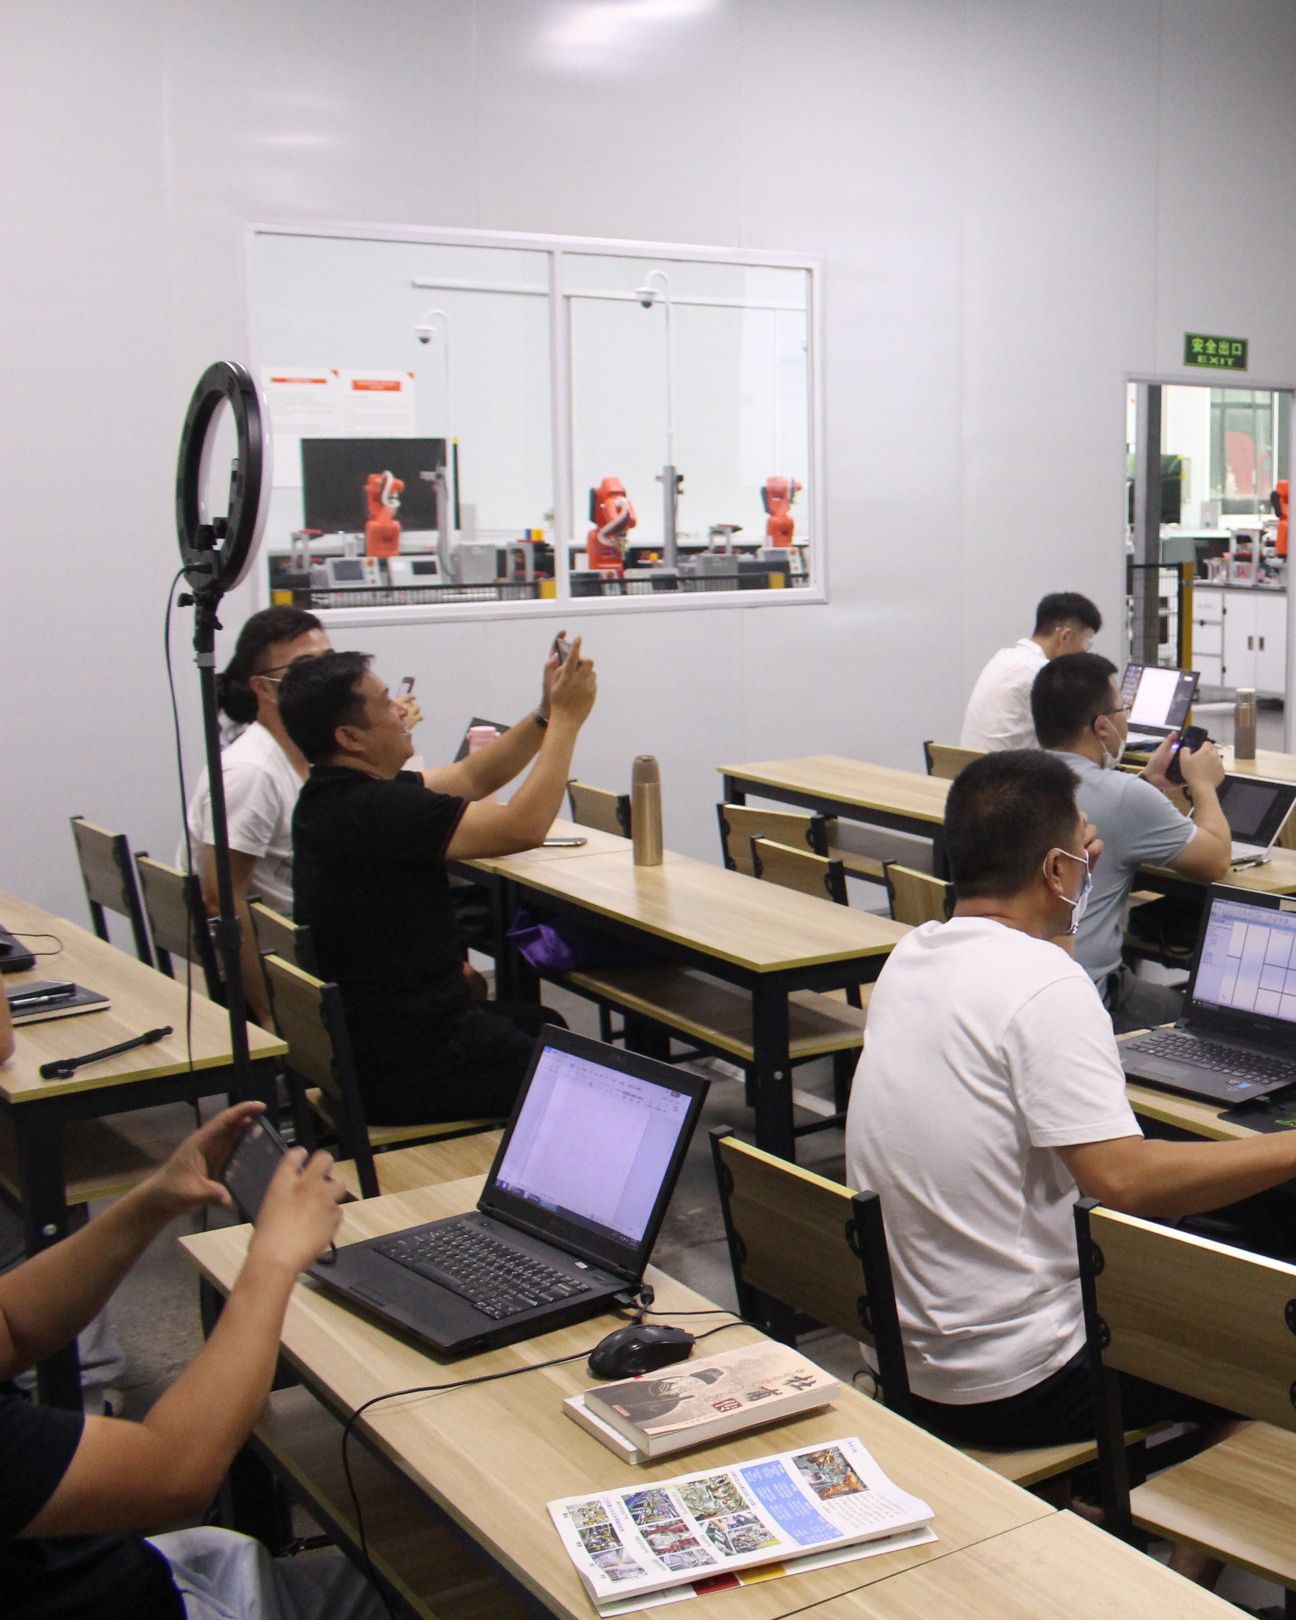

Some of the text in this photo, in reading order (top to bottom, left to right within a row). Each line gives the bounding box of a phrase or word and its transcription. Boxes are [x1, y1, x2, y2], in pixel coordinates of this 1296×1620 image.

[1191, 337, 1242, 355] 安全出口
[1197, 354, 1233, 366] EXIT
